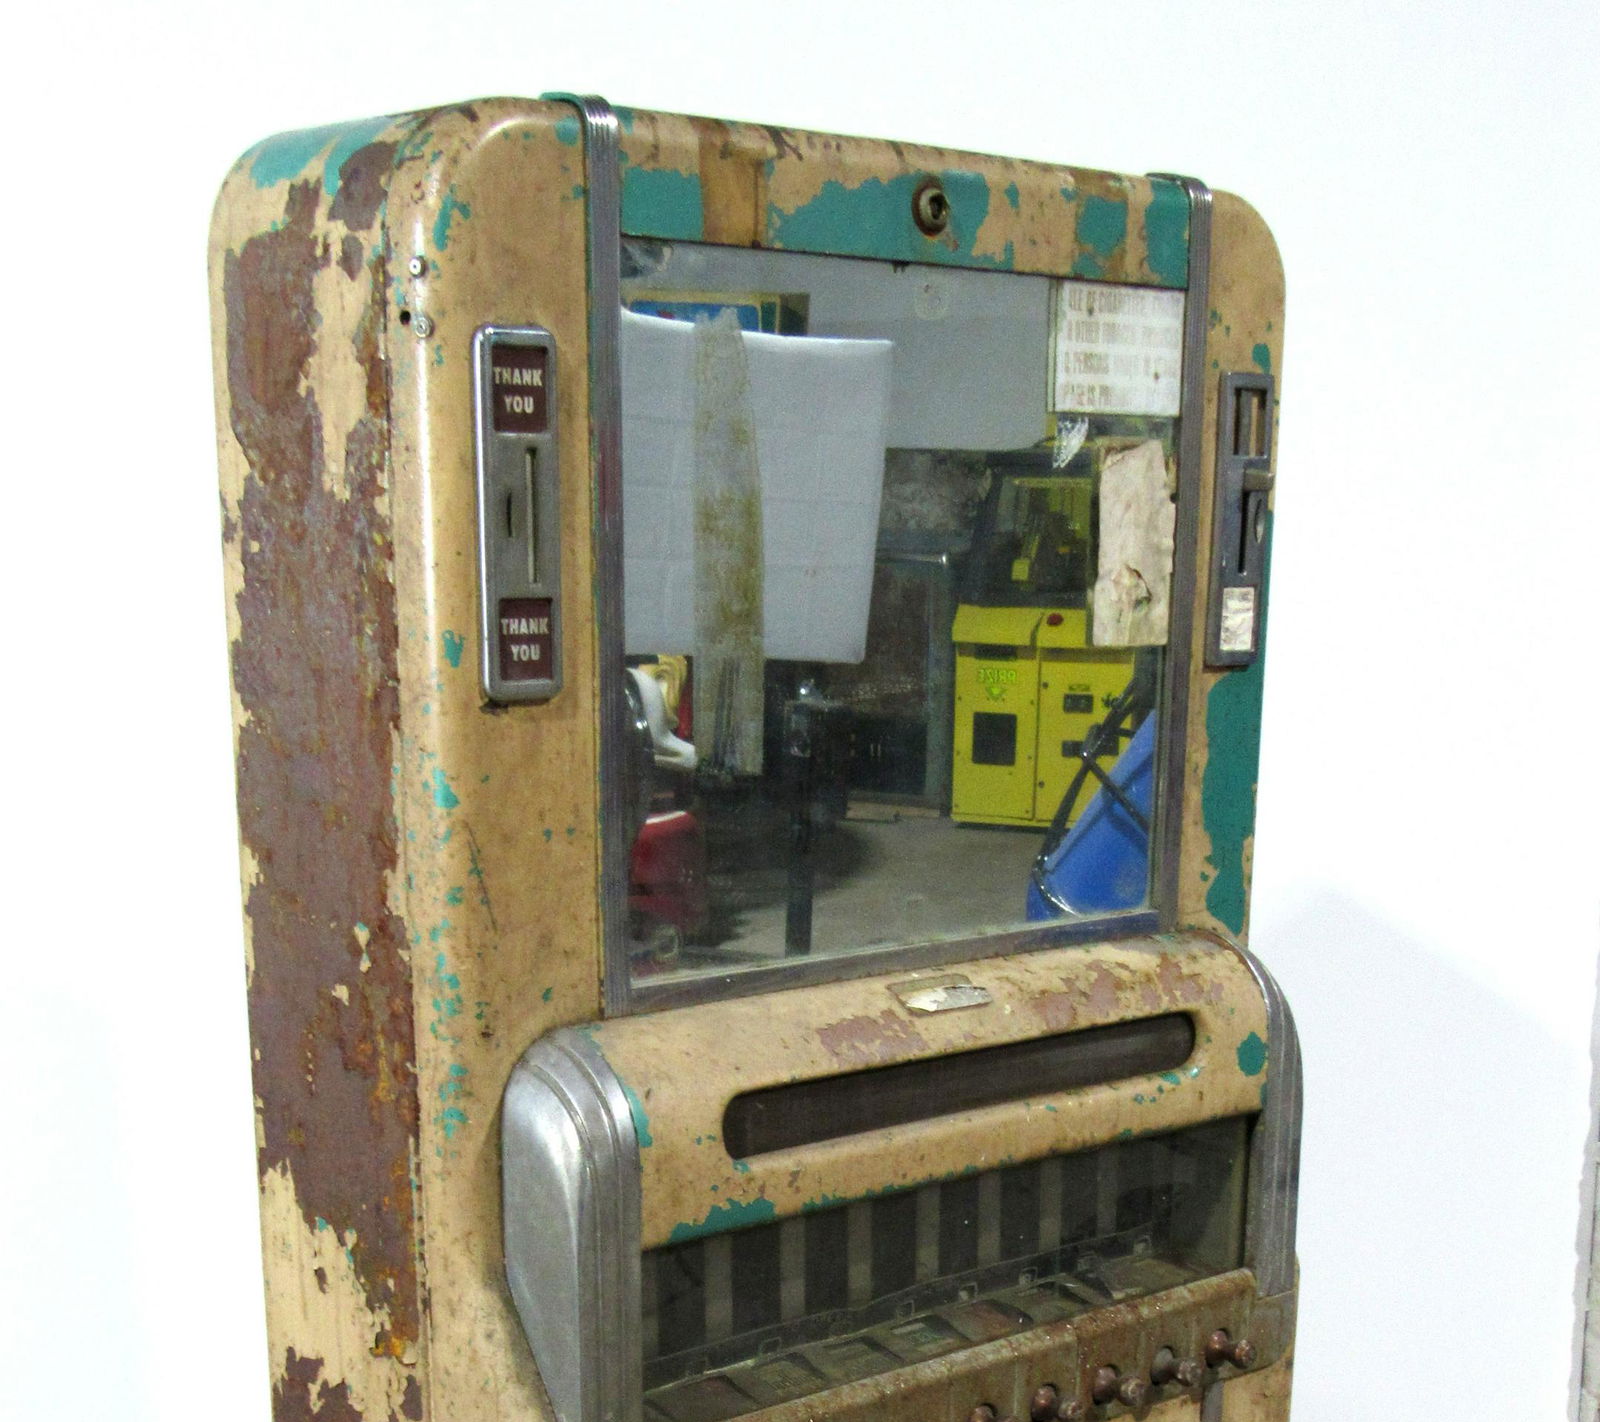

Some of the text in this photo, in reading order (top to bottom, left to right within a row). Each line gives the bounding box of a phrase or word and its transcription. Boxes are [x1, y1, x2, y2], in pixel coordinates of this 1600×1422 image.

[493, 366, 543, 387] THANK
[504, 395, 534, 414] YOU
[501, 617, 549, 635] THANK
[510, 644, 541, 662] YOU
